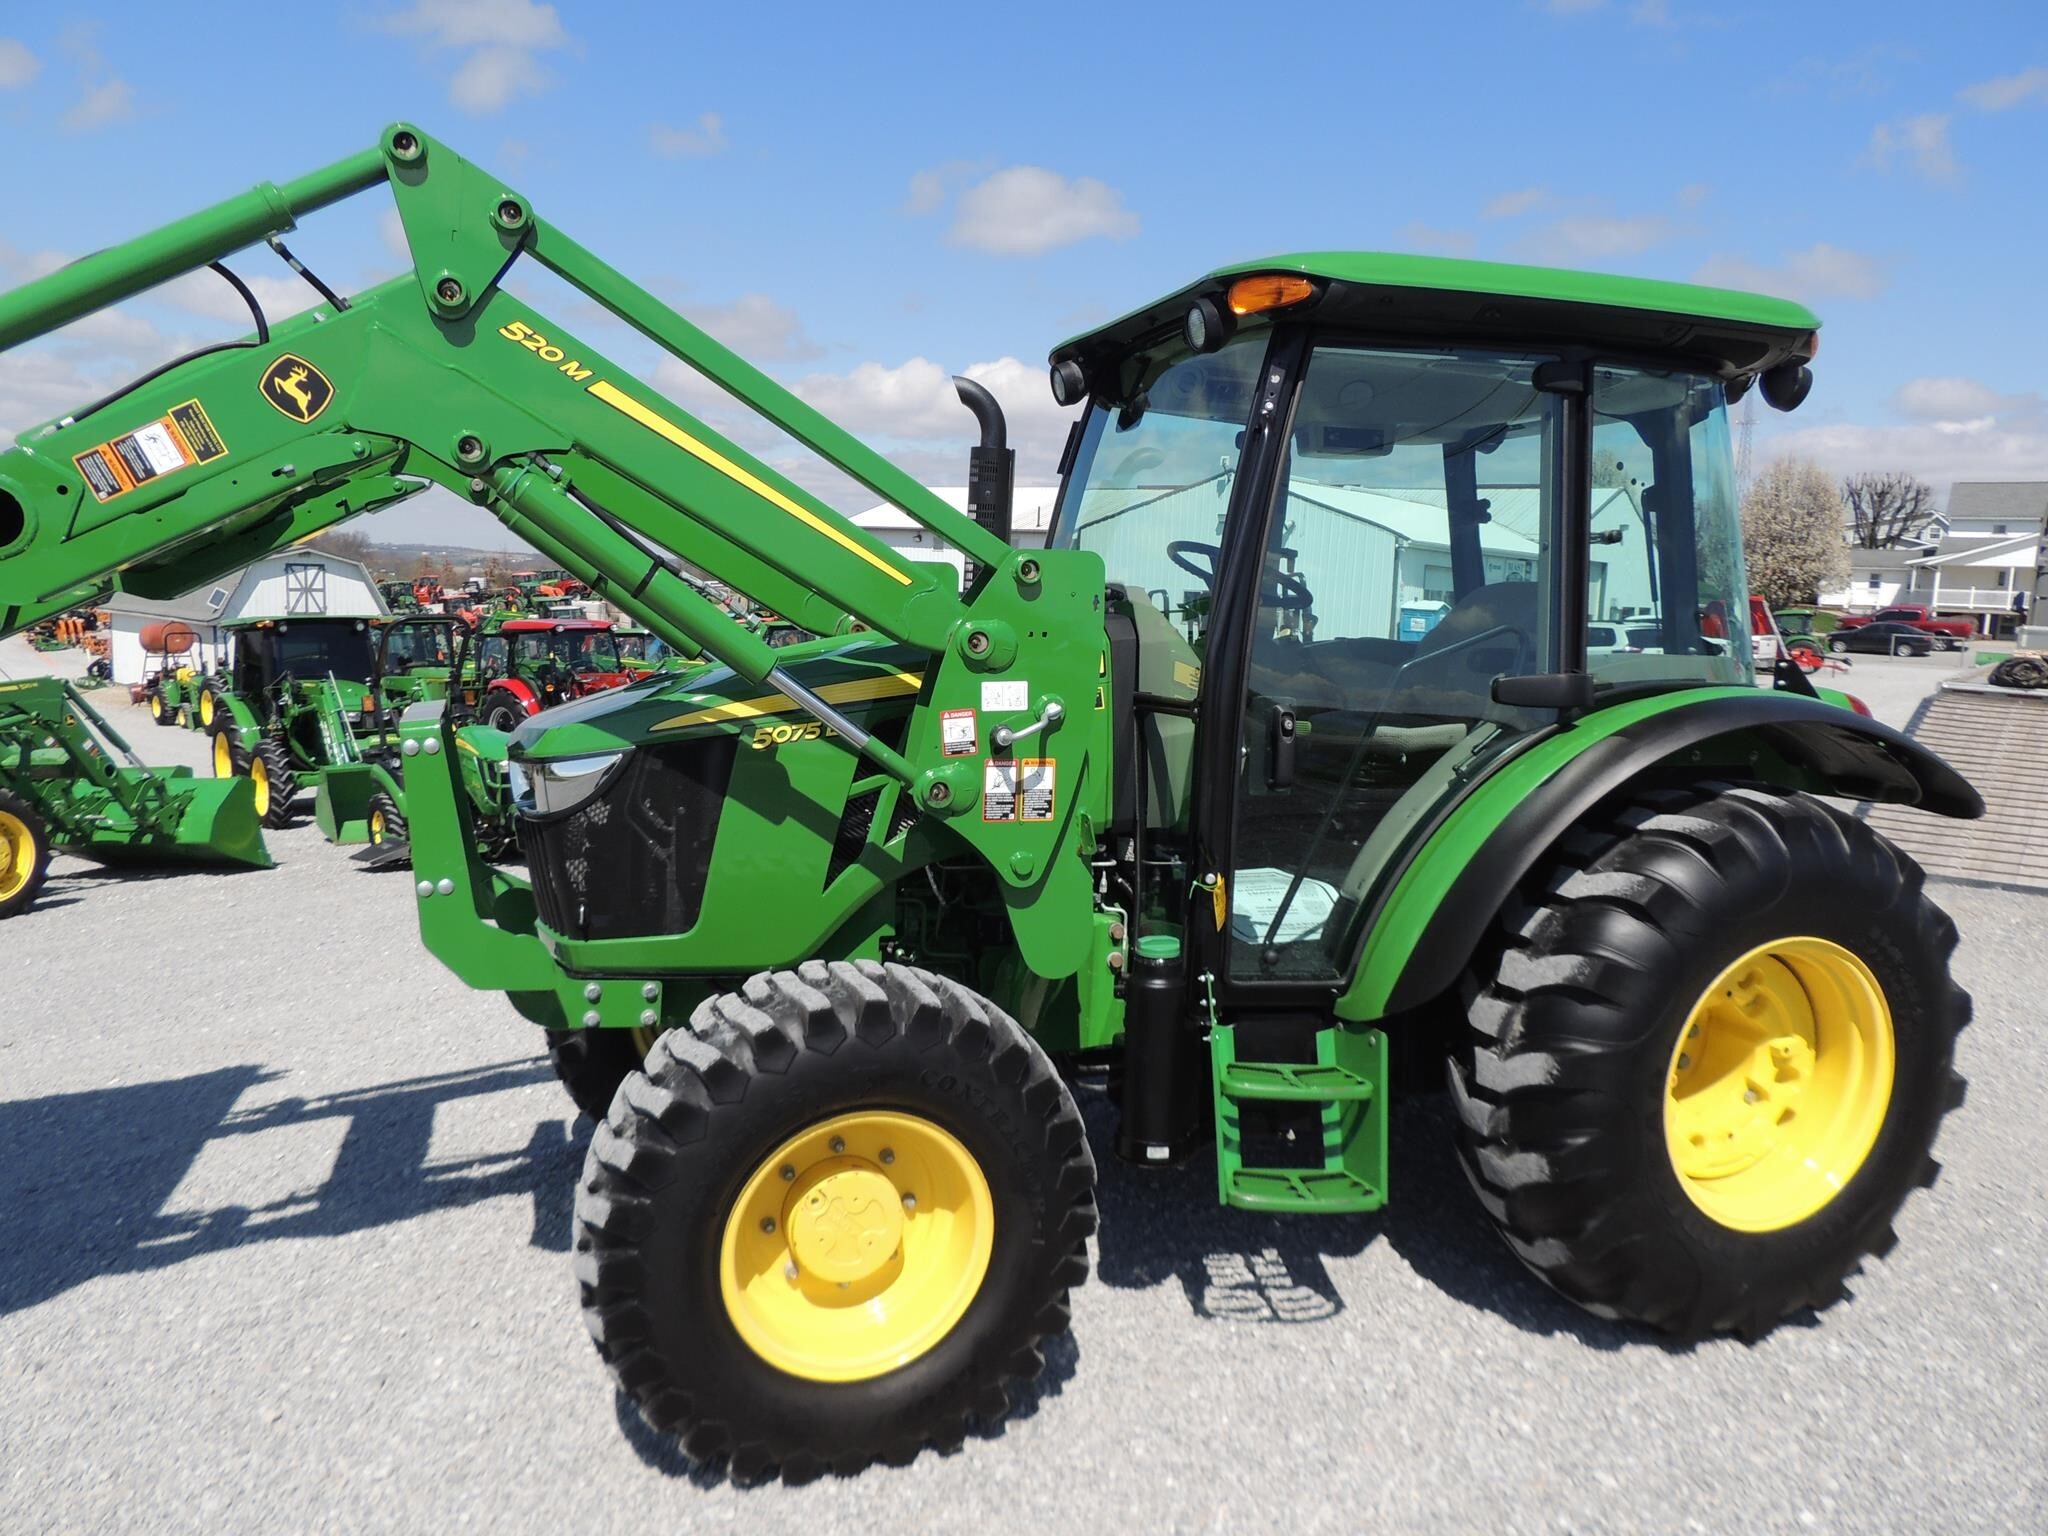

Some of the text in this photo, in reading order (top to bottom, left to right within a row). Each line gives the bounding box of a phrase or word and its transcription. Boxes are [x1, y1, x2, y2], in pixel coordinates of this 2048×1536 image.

[497, 320, 595, 383] 520 M
[950, 710, 973, 718] DANGER
[751, 721, 823, 750] 5075
